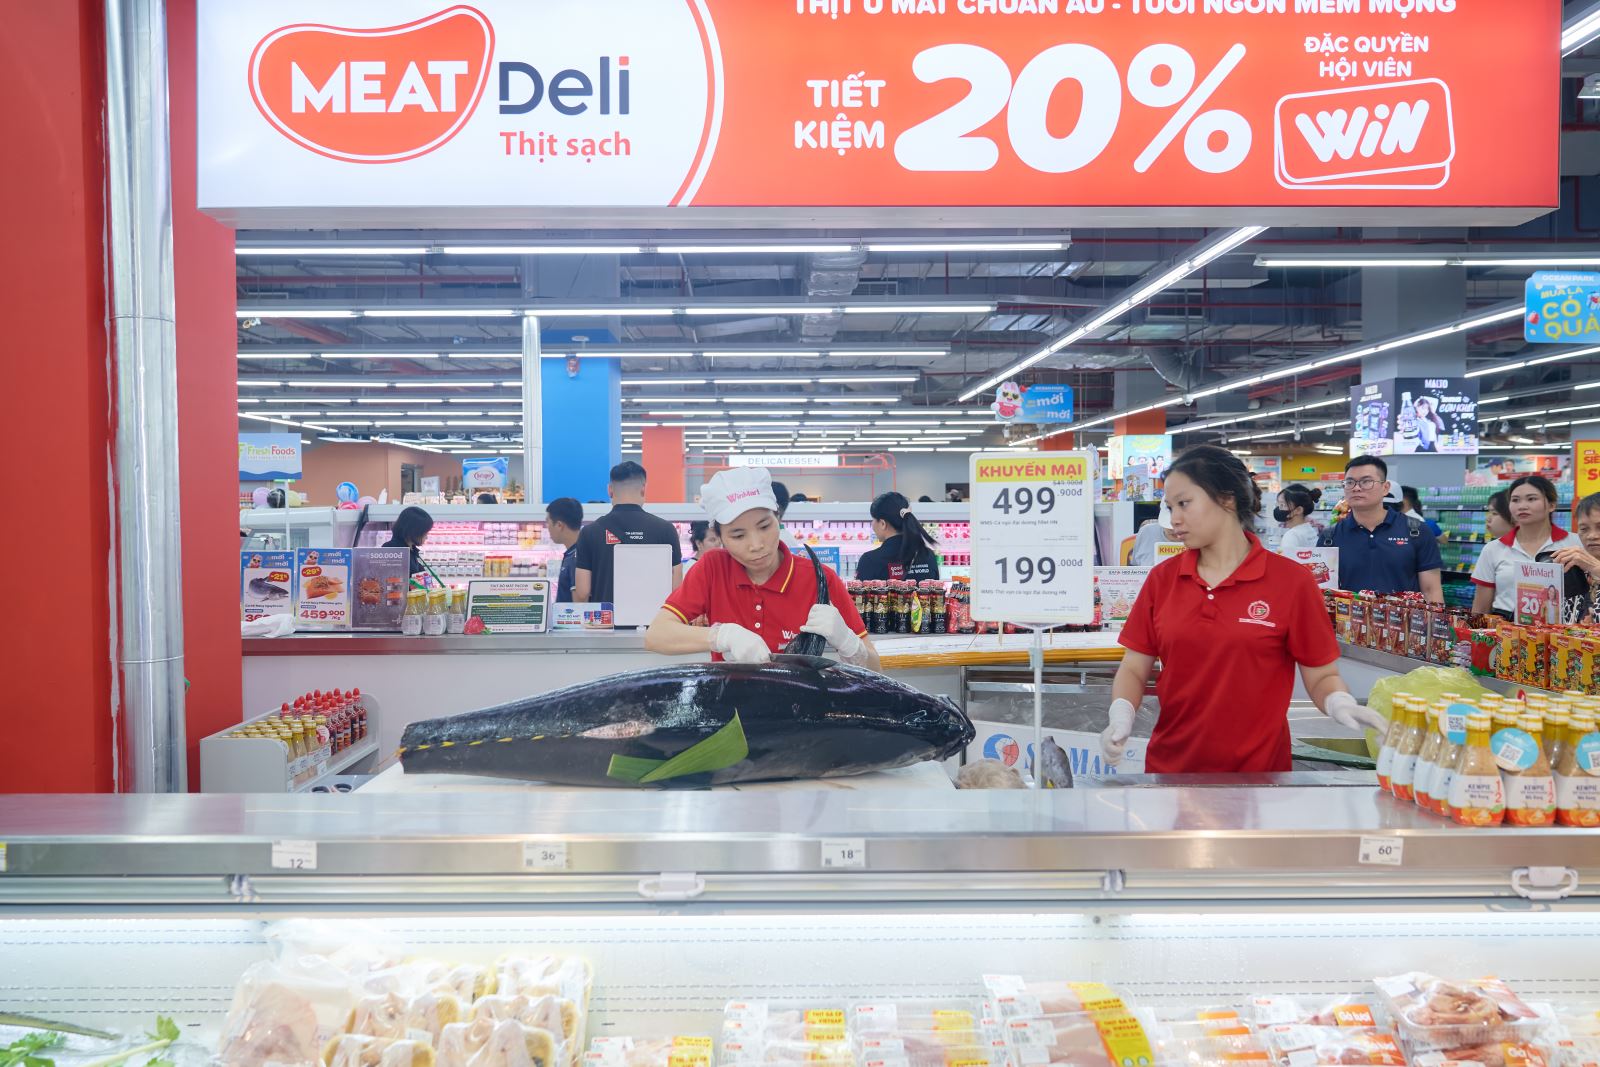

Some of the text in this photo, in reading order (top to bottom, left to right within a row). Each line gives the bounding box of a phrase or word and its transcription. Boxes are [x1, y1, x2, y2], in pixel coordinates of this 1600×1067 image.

[1304, 31, 1429, 57] ĐẶC QUYỀN
[1319, 56, 1412, 81] HỘI VIÊN
[291, 61, 468, 113] MEAT
[499, 56, 630, 115] Deli
[806, 71, 886, 107] TIẾT
[894, 43, 1253, 173] 20%
[794, 112, 885, 156] KIỆM
[500, 131, 631, 163] Thịt sạch
[1037, 392, 1064, 406] mới
[980, 461, 1082, 478] KHUYẾN MẠI
[726, 488, 760, 503] WinMart
[992, 487, 1055, 514] 499
[995, 557, 1056, 584] 199
[1522, 565, 1554, 578] WinMart
[300, 610, 327, 619] 459
[542, 851, 555, 860] 36
[841, 850, 853, 859] 18
[1379, 846, 1392, 855] 60
[290, 858, 303, 869] 12
